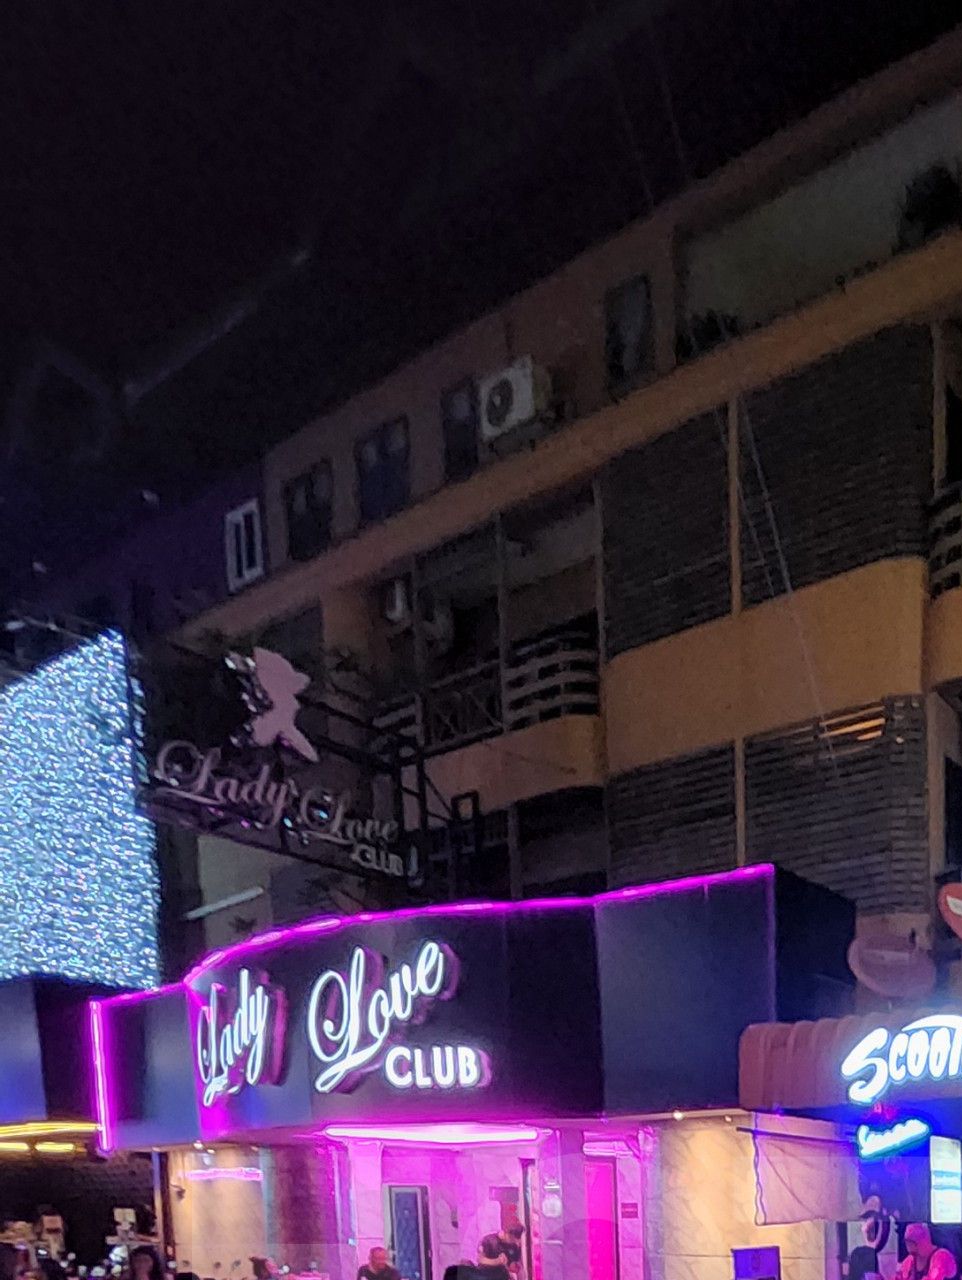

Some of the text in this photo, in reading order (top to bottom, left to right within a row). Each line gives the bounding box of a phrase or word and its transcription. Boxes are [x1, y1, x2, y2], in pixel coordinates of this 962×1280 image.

[154, 740, 398, 846] Lady Love
[197, 941, 446, 1106] Lady Love
[385, 1046, 480, 1088] CLUB
